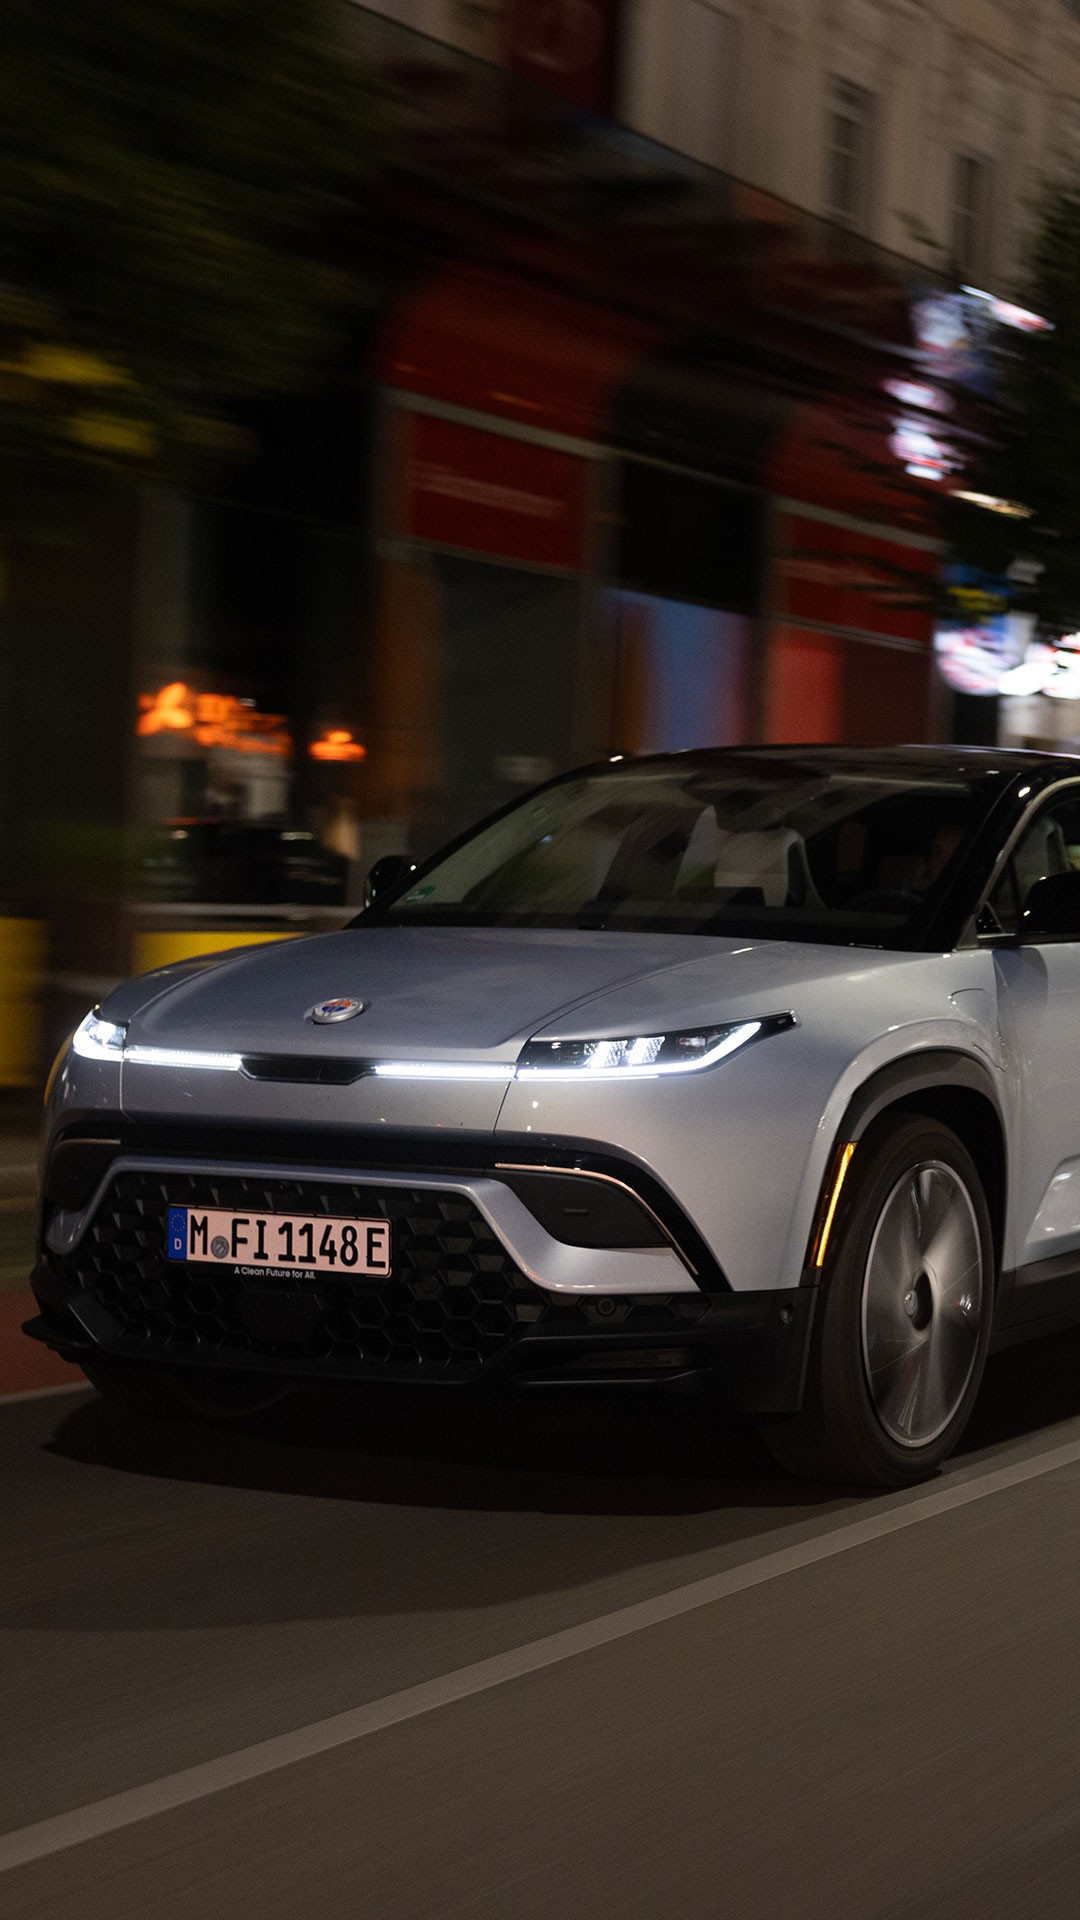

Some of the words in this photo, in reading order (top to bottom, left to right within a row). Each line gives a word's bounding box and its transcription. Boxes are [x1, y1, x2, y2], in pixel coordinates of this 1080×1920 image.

[190, 1214, 208, 1256] M
[174, 1237, 182, 1251] D
[234, 1267, 240, 1275] A
[241, 1267, 265, 1276] Clean
[266, 1268, 291, 1278] Future
[292, 1270, 303, 1279] for
